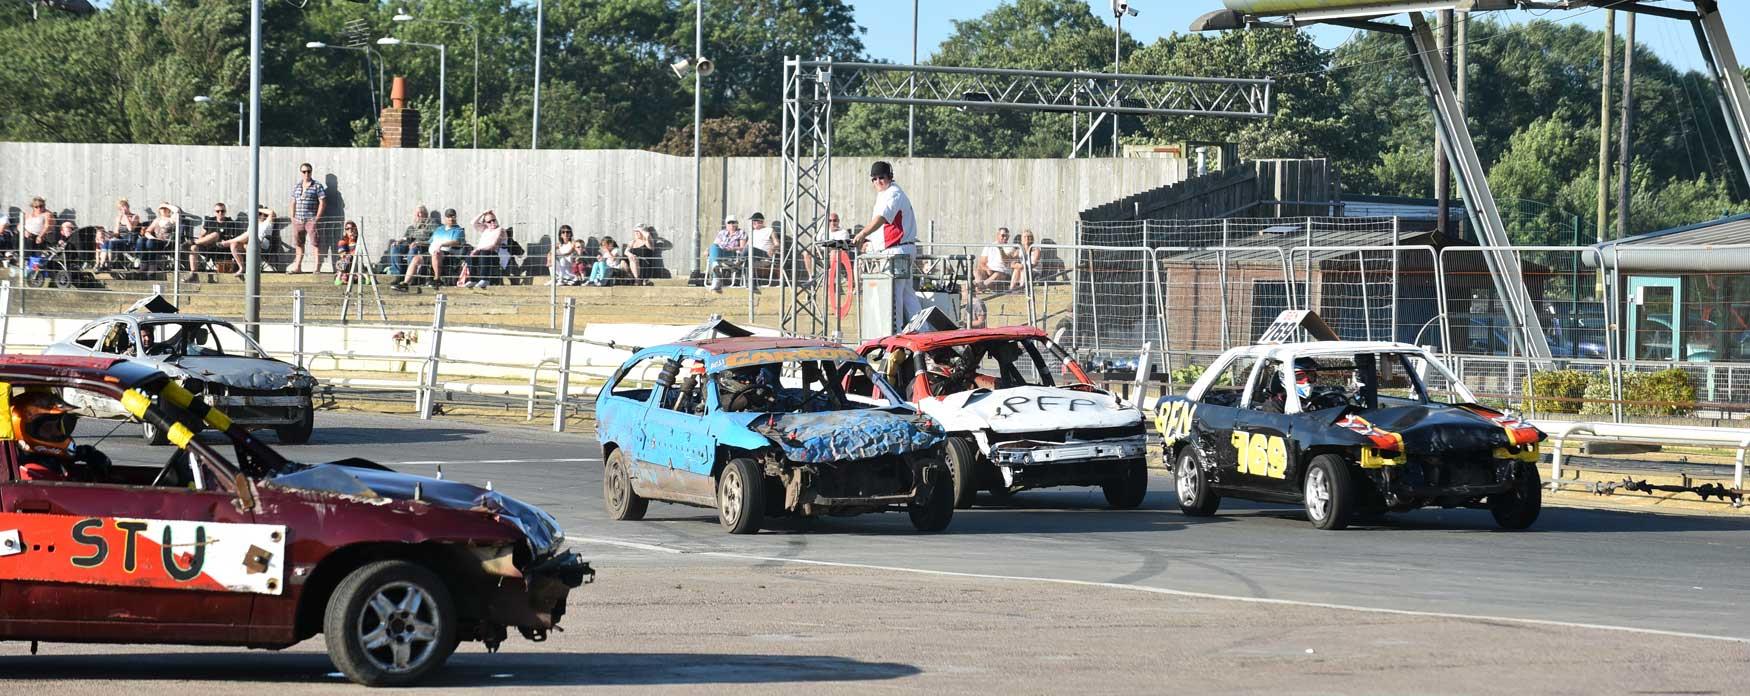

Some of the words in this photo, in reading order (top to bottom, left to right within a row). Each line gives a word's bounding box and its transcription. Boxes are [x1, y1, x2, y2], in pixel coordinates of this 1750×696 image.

[1262, 321, 1297, 341] 769
[1002, 396, 1096, 413] PFP
[1155, 400, 1198, 447] BEN
[1231, 430, 1288, 479] 769
[70, 517, 207, 581] STU
